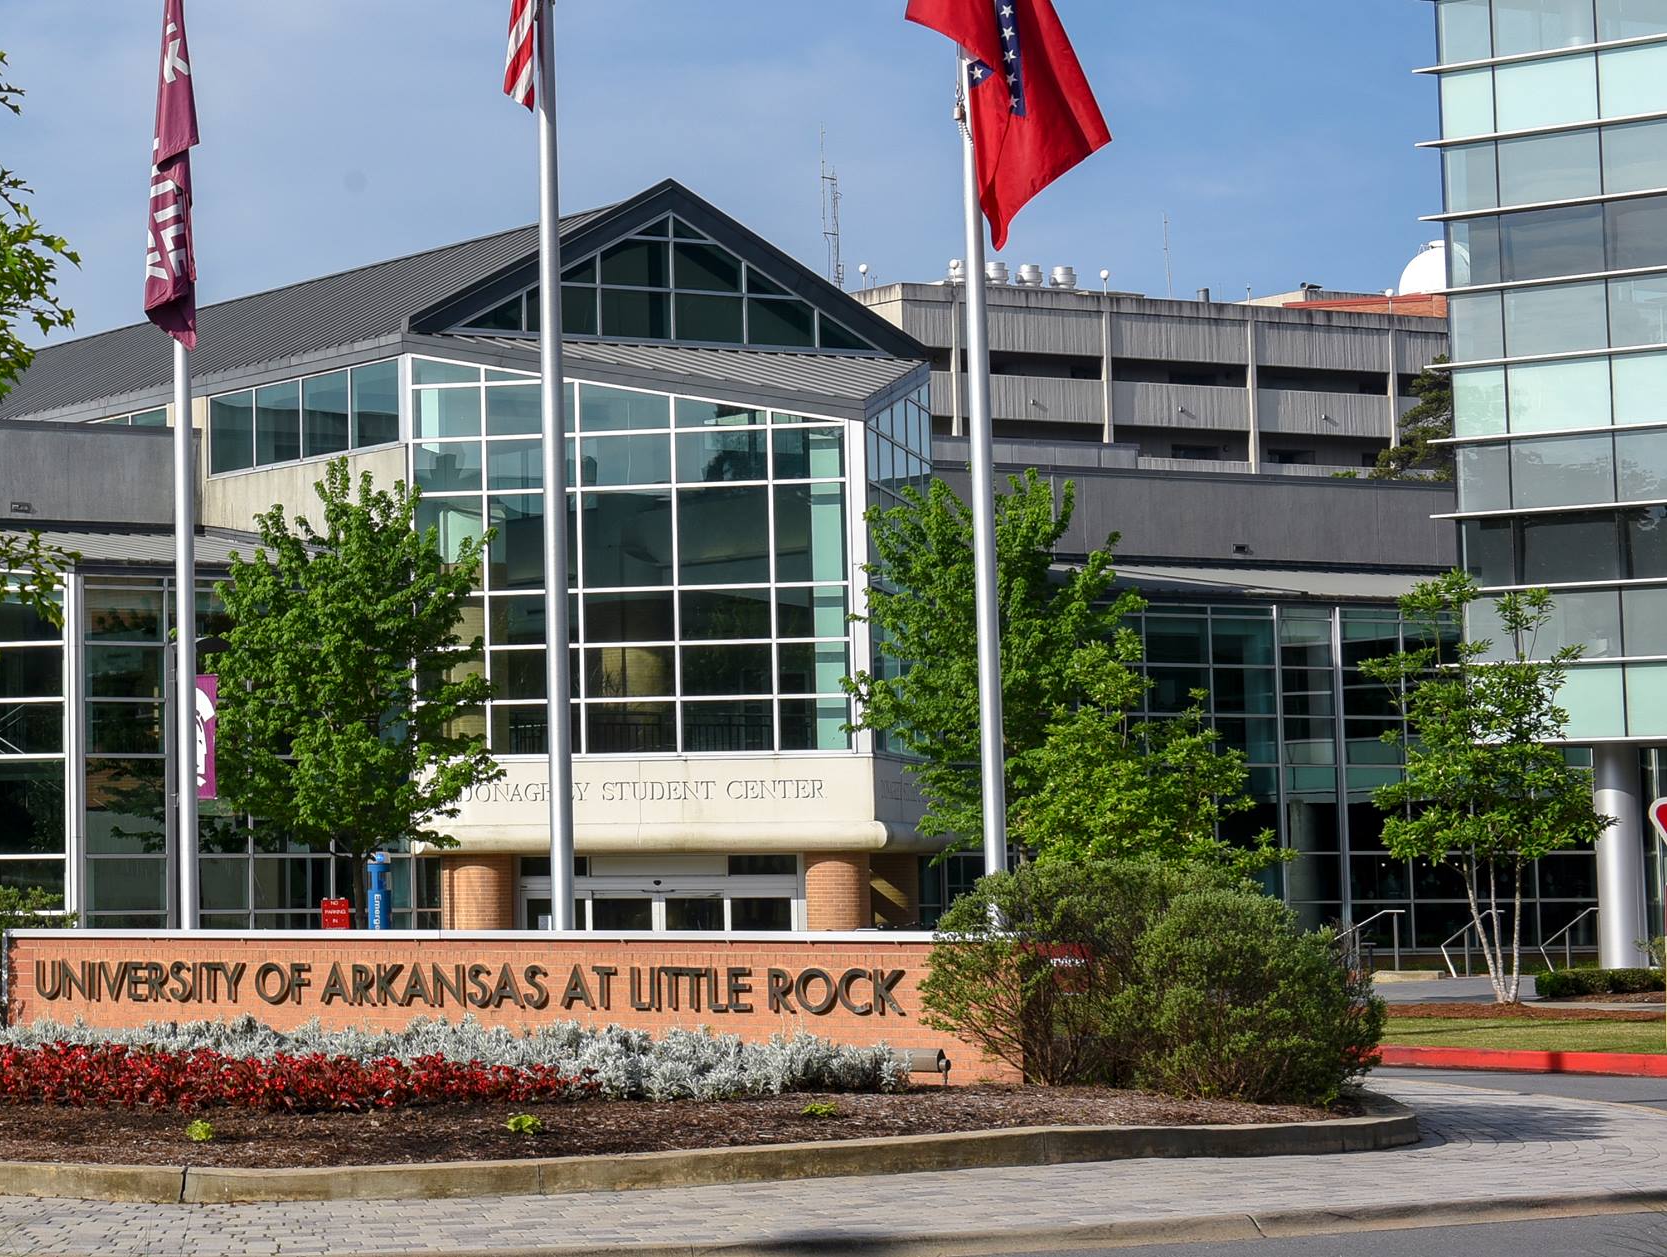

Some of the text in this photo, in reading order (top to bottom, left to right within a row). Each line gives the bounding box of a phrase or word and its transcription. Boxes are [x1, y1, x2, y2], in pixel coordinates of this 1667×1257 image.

[602, 780, 716, 802] STUDENT
[725, 778, 825, 800] CENTER
[35, 959, 907, 1016] UNIVERSITY OF ARKANSAS AT LITTLE ROCK
